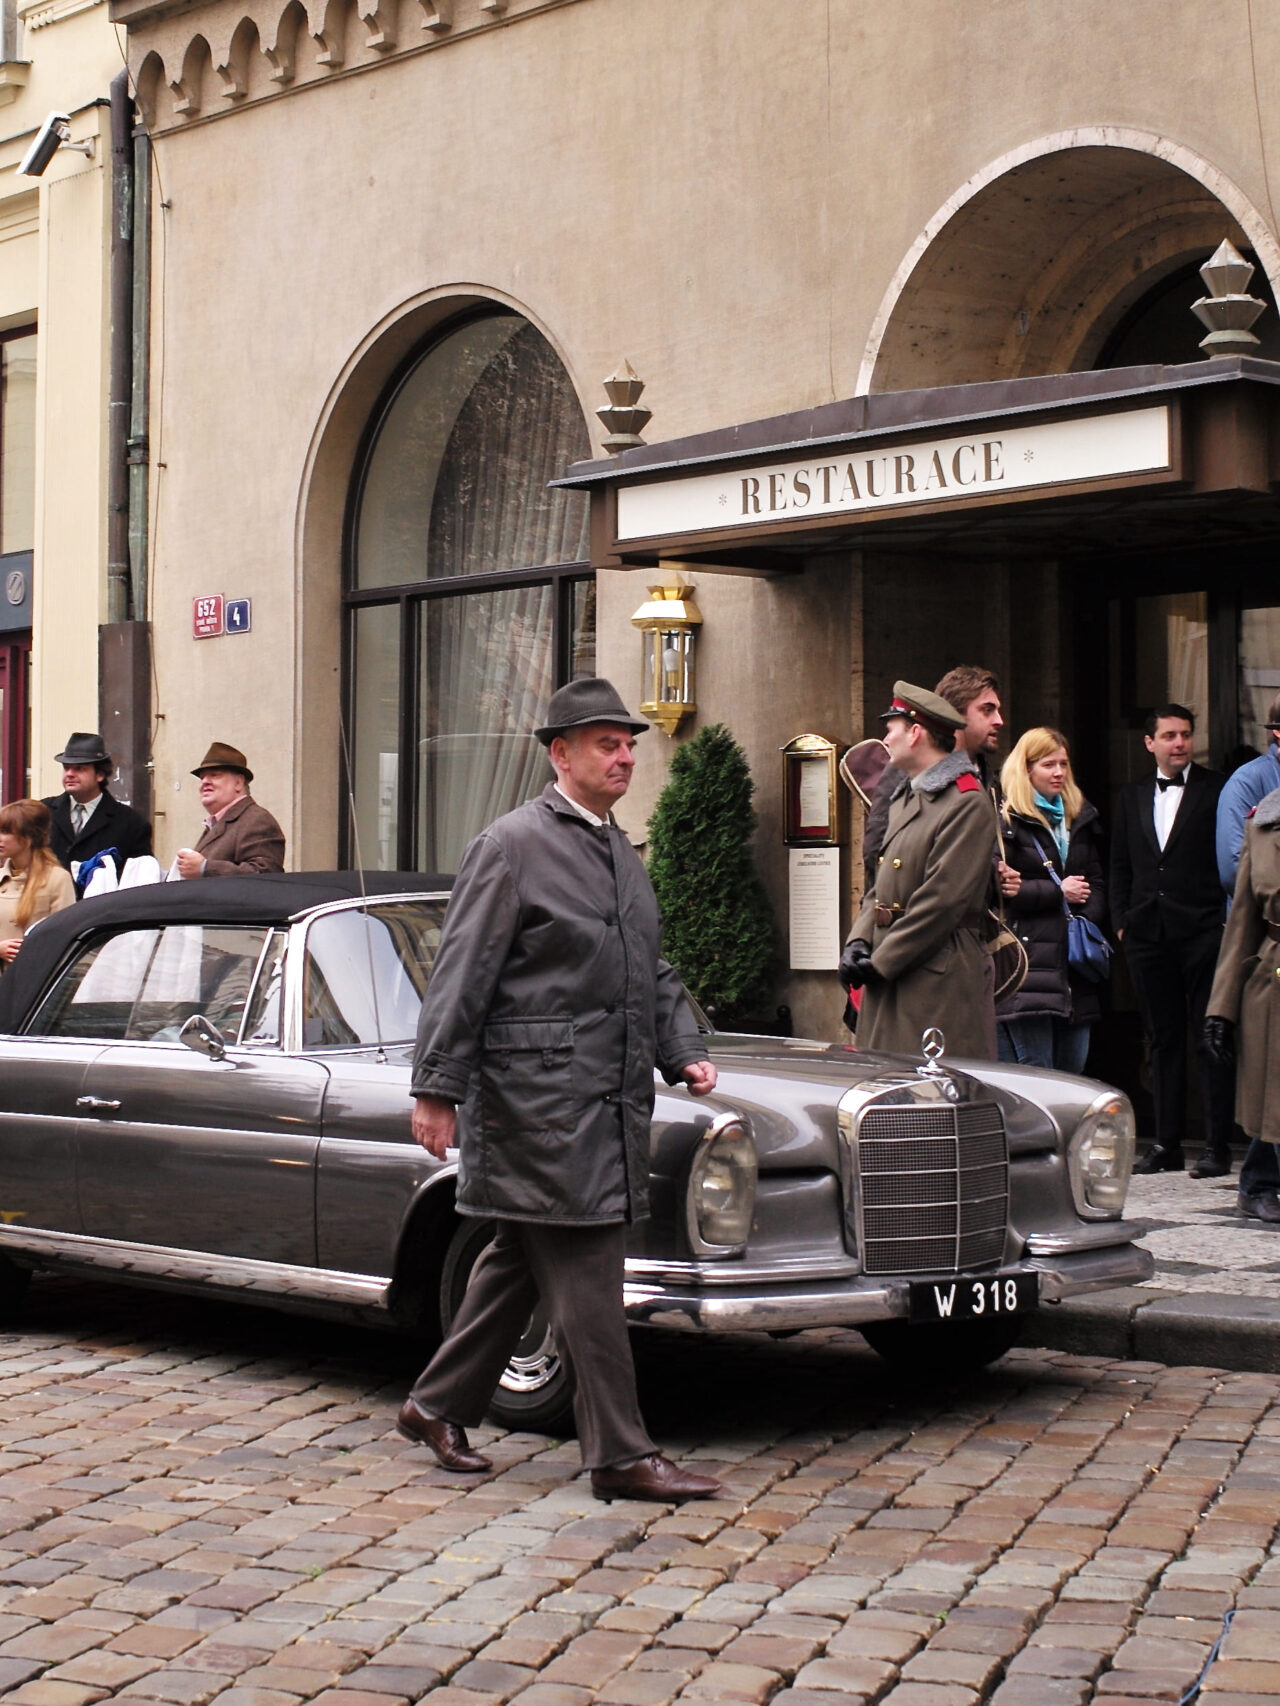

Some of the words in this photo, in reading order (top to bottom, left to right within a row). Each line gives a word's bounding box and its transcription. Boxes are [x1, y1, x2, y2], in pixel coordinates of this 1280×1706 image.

[741, 440, 1006, 516] RESTAURACE
[197, 599, 216, 618] 652
[233, 607, 241, 626] 4
[933, 1283, 956, 1318] W
[971, 1279, 1017, 1314] 318
